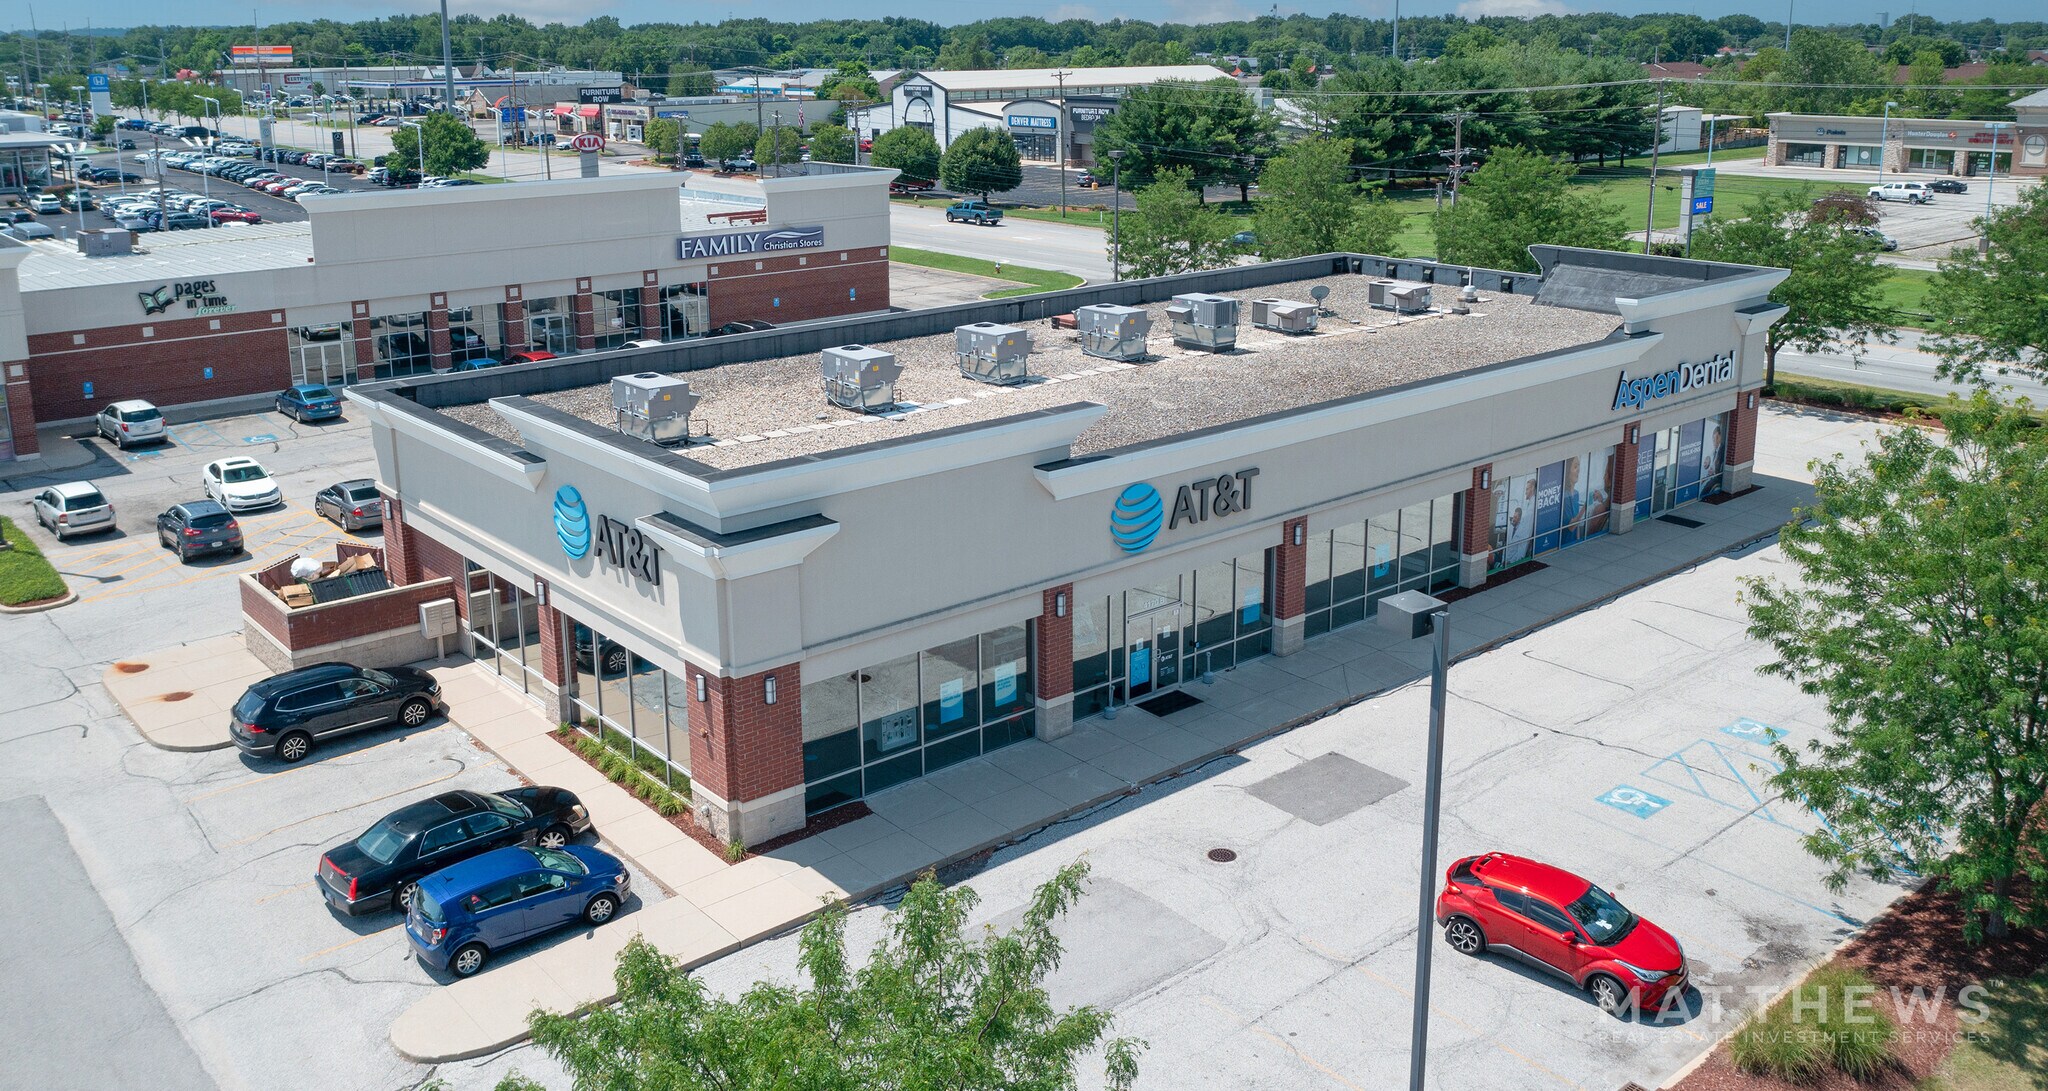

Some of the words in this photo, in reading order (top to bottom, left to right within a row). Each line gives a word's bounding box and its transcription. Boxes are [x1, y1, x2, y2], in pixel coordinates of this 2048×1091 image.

[581, 88, 620, 96] FURNITURE
[1010, 116, 1029, 126] DENVER
[1030, 117, 1052, 127] MATTRESS
[578, 138, 600, 147] KIA
[1695, 201, 1707, 209] SALE
[681, 233, 760, 259] FAMILY
[763, 240, 798, 251] Christian
[799, 239, 823, 248] Stores
[175, 280, 216, 301] pages
[187, 299, 197, 309] in
[203, 296, 228, 307] time
[195, 304, 238, 317] forever
[1538, 484, 1561, 498] MONEY
[1169, 467, 1260, 530] AT&T
[1537, 493, 1561, 510] BACK
[593, 514, 664, 587] AT&T
